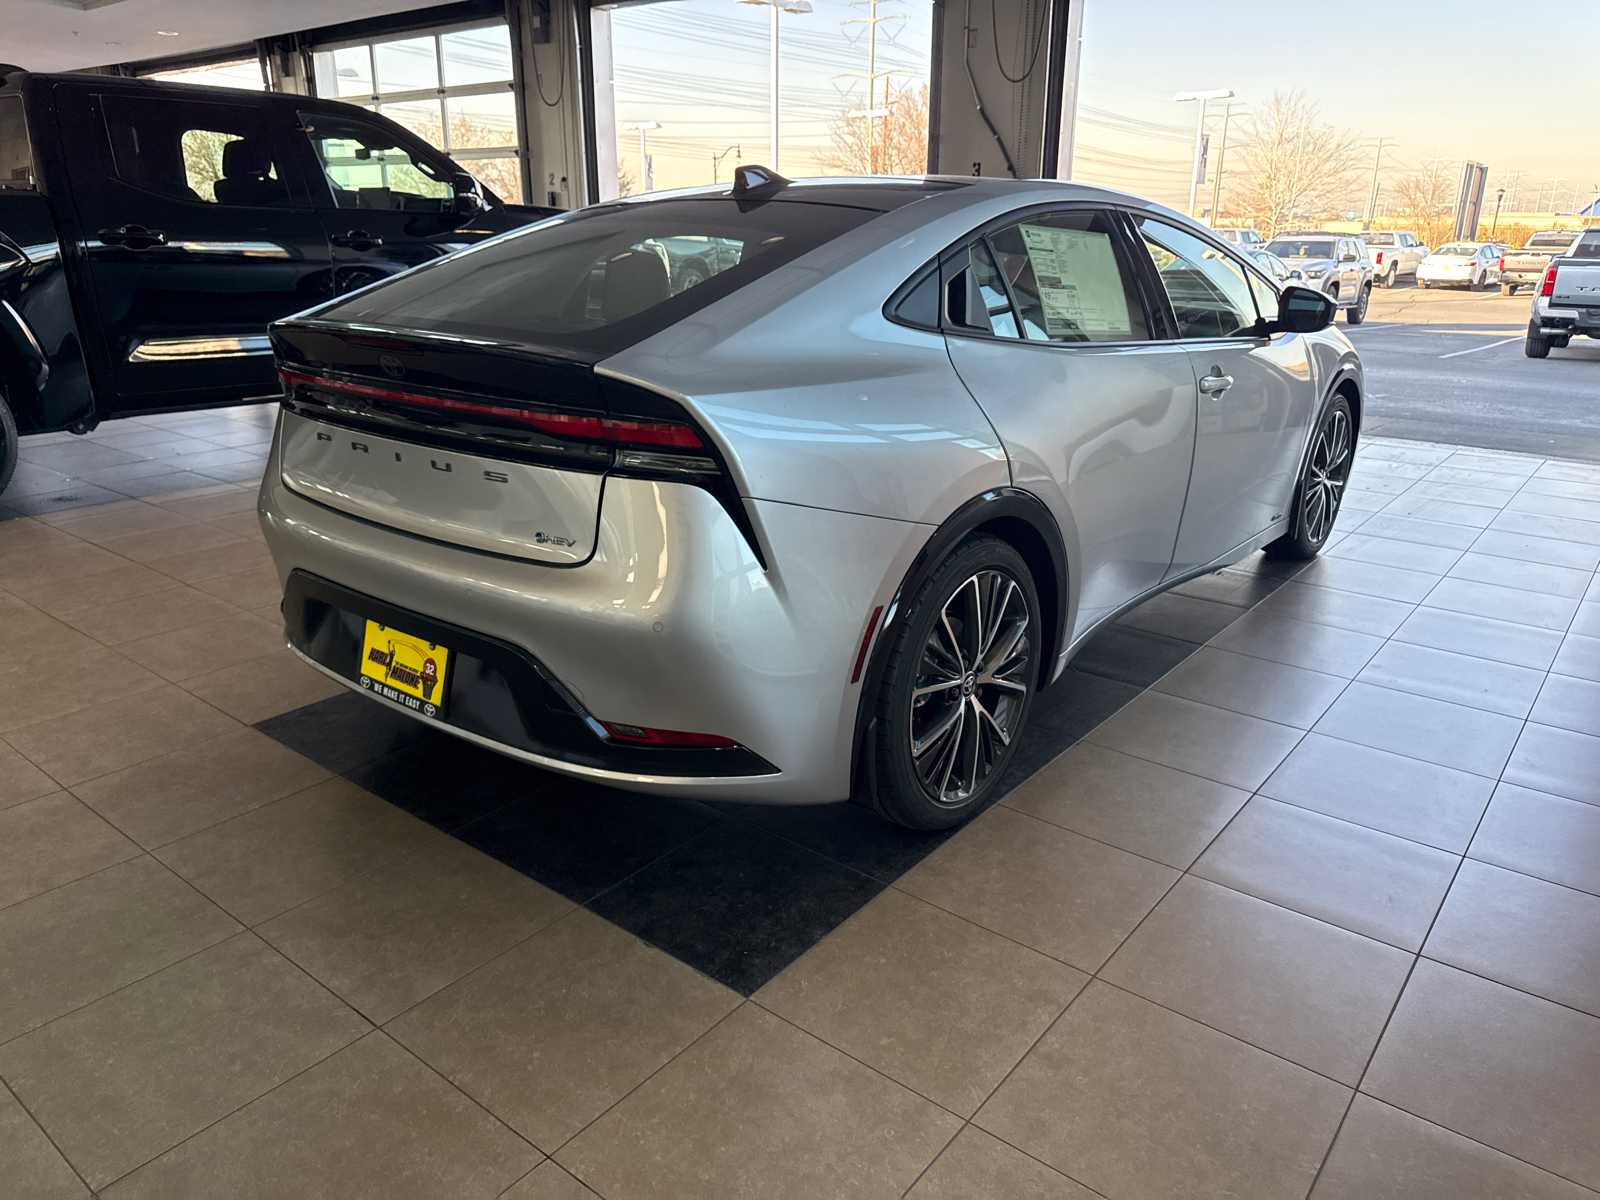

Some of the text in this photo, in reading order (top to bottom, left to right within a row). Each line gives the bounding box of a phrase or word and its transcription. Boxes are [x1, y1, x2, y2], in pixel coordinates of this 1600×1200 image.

[549, 173, 555, 186] 2
[972, 162, 981, 177] 3
[317, 432, 508, 484] PRIUS
[368, 647, 390, 667] KARL
[390, 664, 421, 690] MALONE
[425, 662, 435, 676] 32
[374, 682, 420, 710] WE MAKE IT EASY
